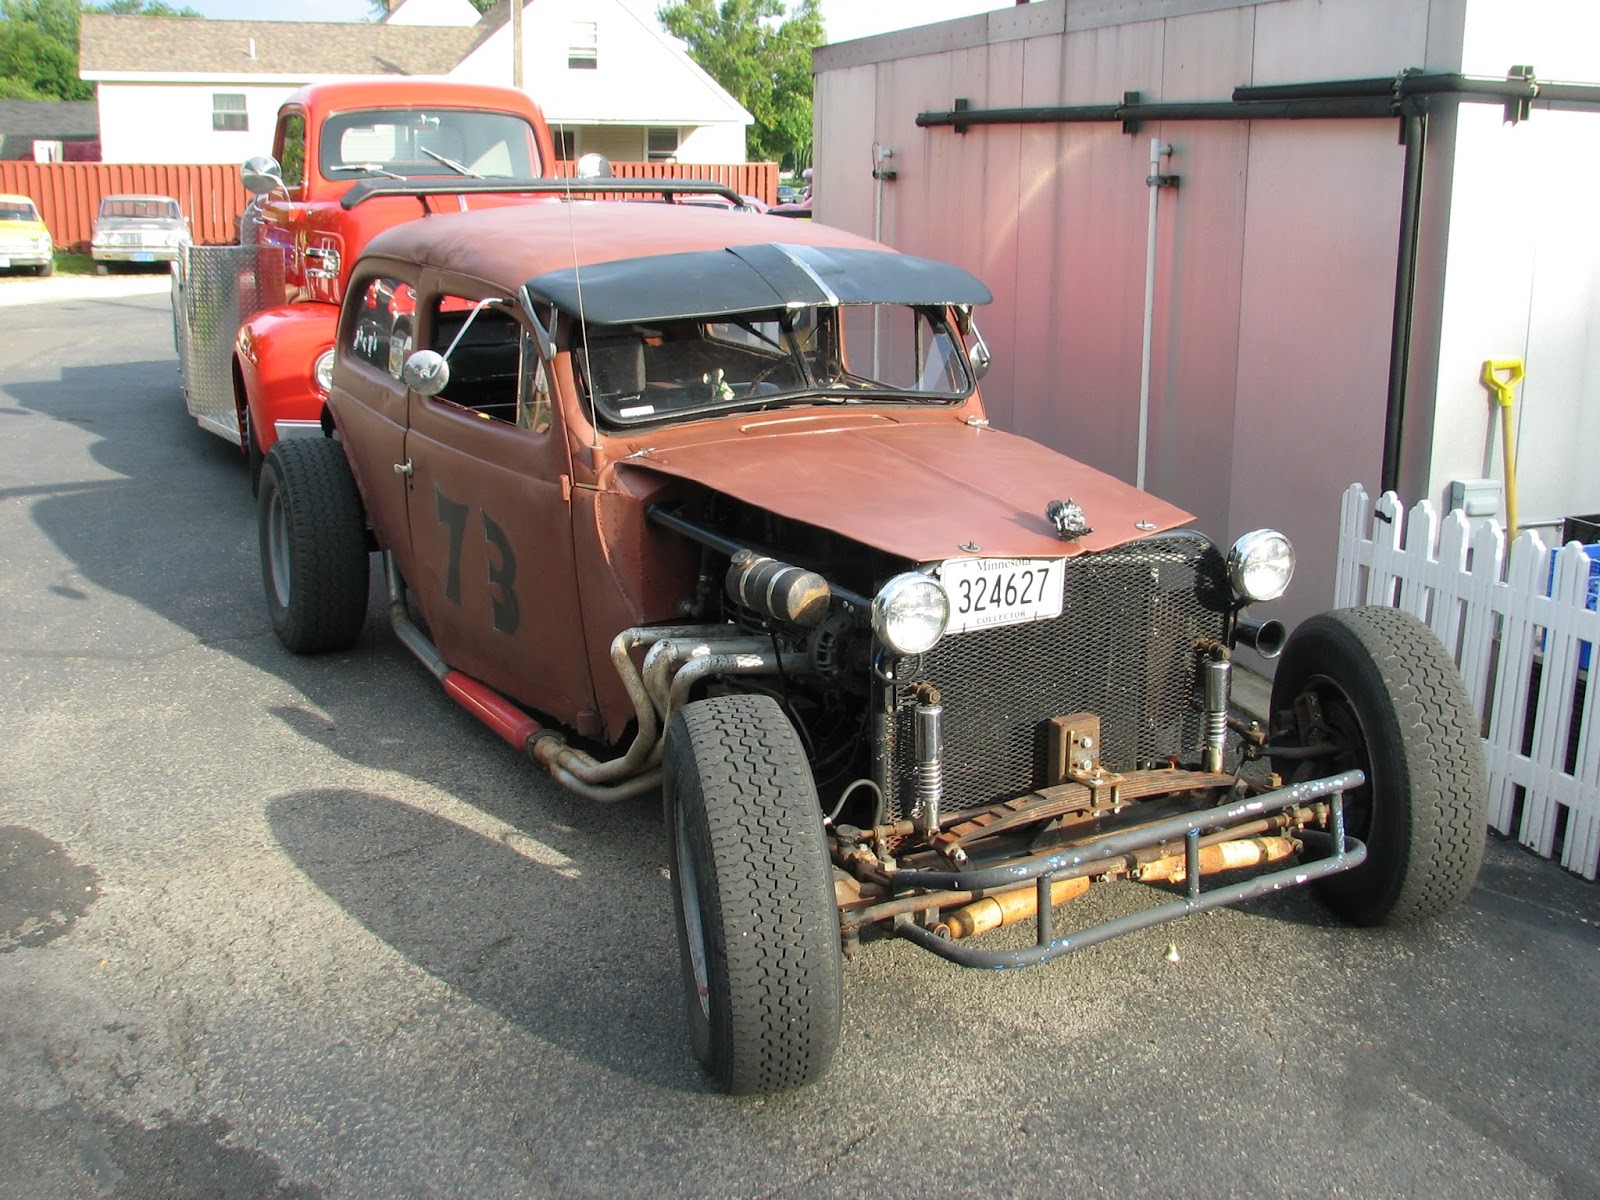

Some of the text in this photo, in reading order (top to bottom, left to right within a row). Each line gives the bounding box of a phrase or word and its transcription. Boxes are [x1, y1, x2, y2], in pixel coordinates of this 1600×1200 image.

[435, 483, 520, 635] 73
[977, 558, 1031, 572] Minnesota
[959, 568, 1049, 613] 324627
[976, 611, 1026, 624] COLLECTOR
